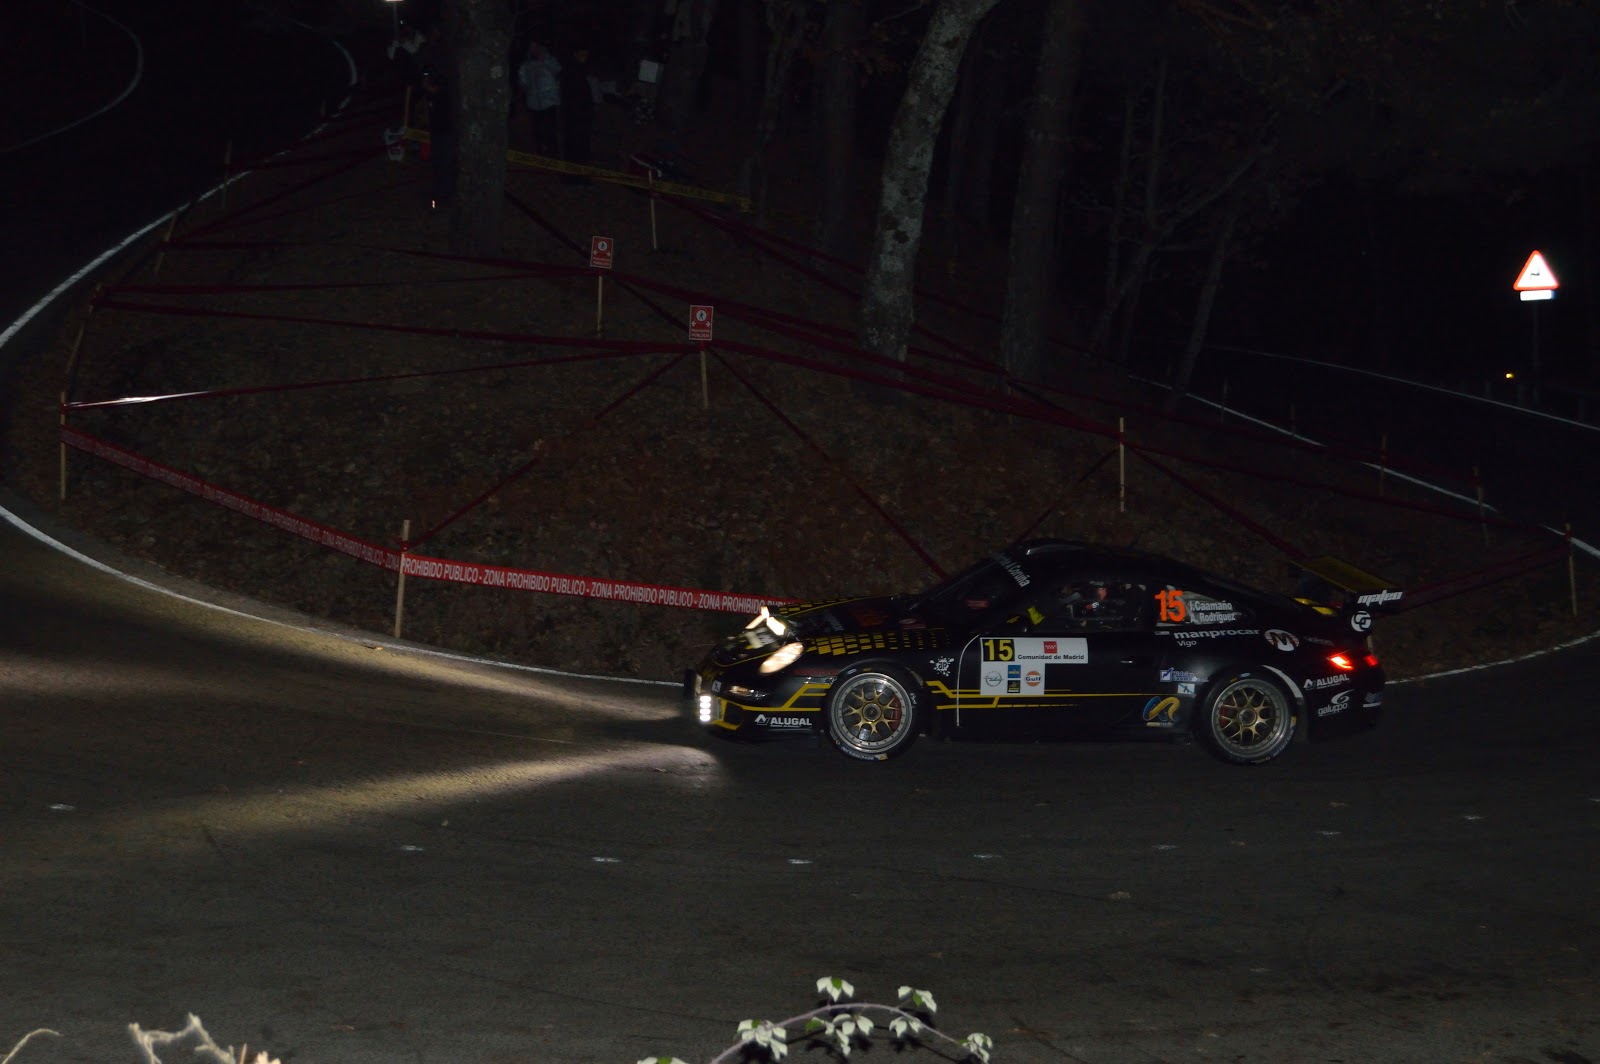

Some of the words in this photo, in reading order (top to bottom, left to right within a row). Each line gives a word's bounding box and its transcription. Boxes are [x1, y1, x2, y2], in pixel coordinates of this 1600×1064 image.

[444, 563, 479, 583] PUBLICO
[483, 569, 505, 586] ZONA
[507, 572, 550, 591] PROHIBIDO
[551, 579, 585, 596] PUBLICO
[591, 582, 613, 598] ZONA
[614, 584, 657, 603] PROHIBIDO
[658, 589, 693, 607] PUBLICO
[699, 593, 720, 609] ZONA
[722, 596, 765, 614] PROHIBIDO
[1154, 589, 1186, 623] 15
[1174, 629, 1260, 639] manprocar
[983, 639, 1014, 661] 15
[1176, 640, 1197, 648] Vigo
[1316, 673, 1350, 687] ALUGAL
[1318, 703, 1348, 716] galuppo
[771, 716, 813, 726] ALUGAL
